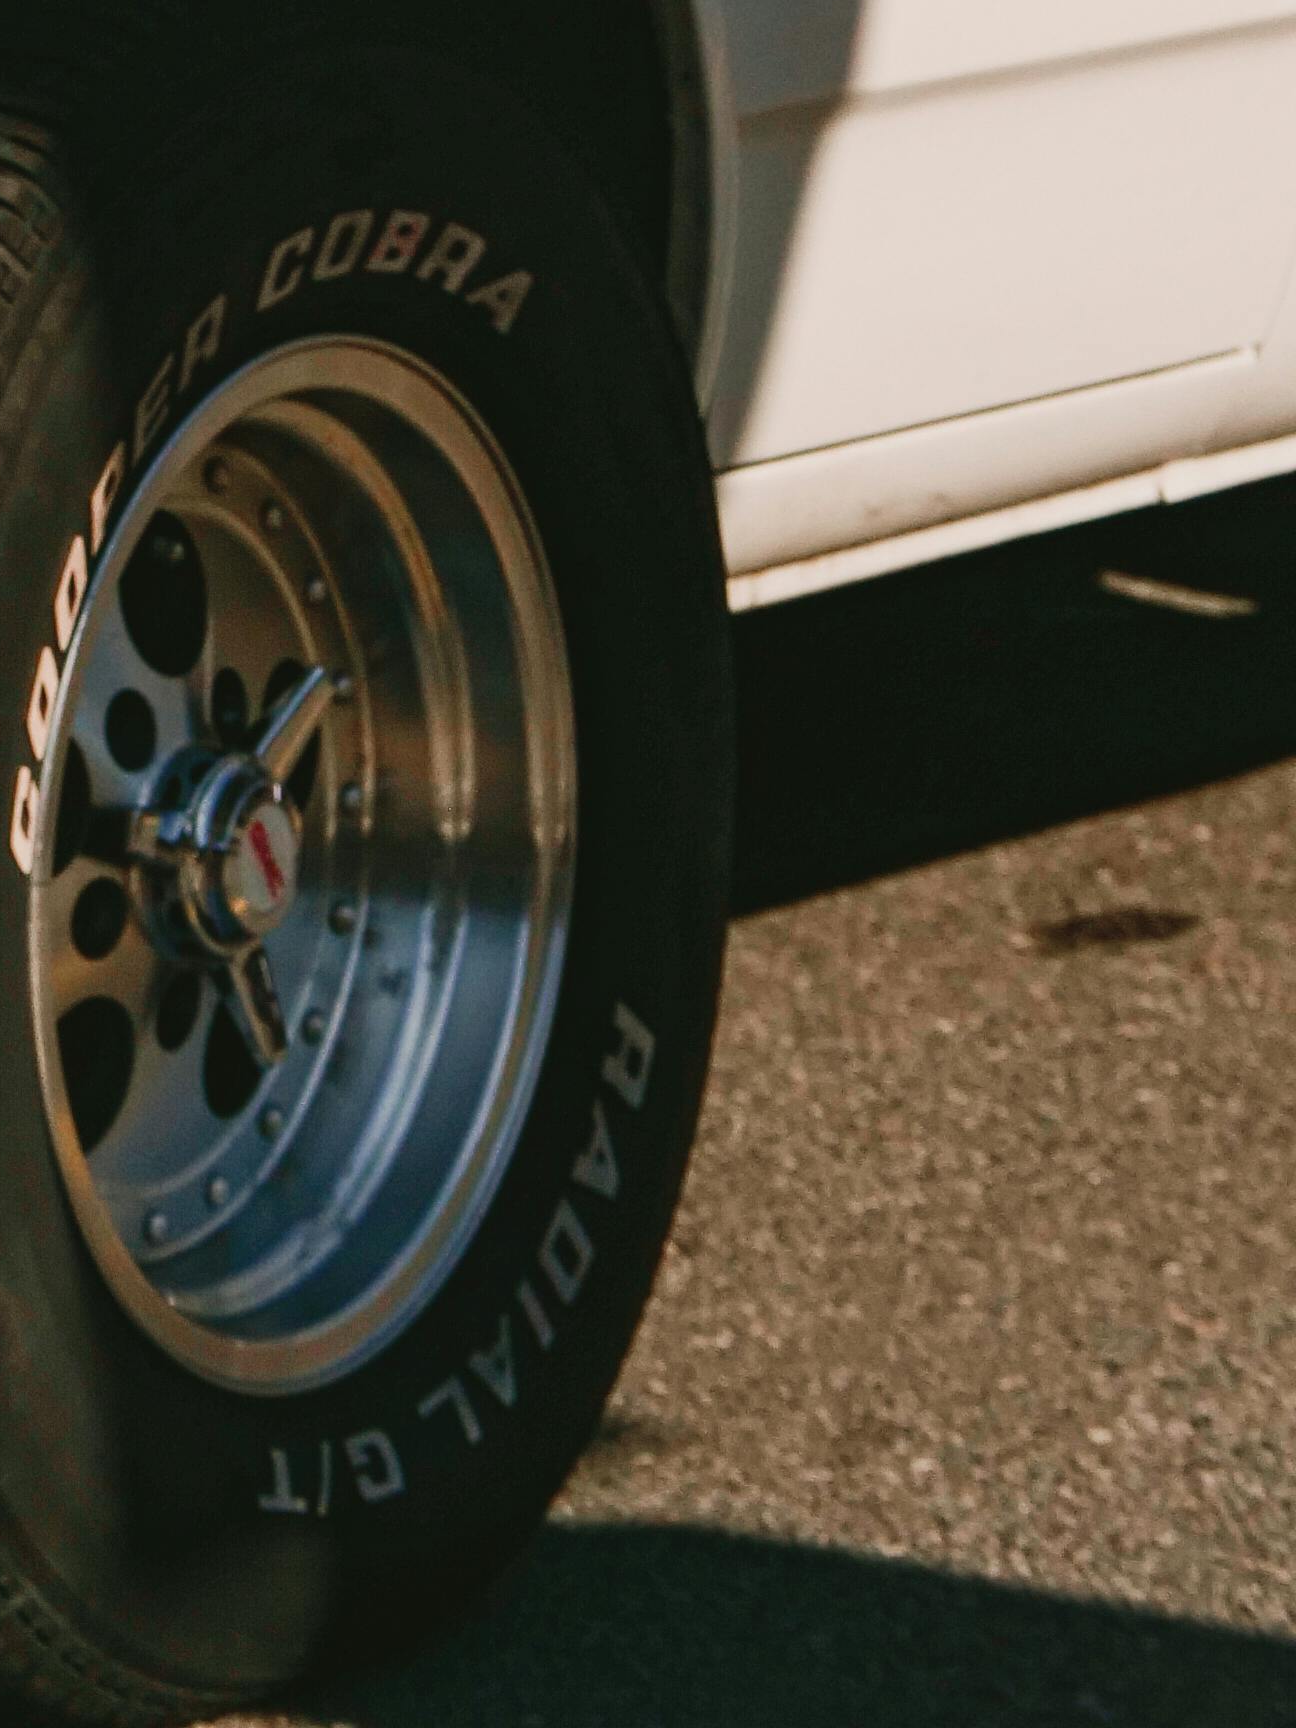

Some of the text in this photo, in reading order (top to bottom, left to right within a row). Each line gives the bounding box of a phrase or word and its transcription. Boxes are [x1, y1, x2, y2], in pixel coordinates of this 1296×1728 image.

[10, 209, 534, 875] COOPER COBRA
[258, 1001, 656, 1518] RADIAL G/T
